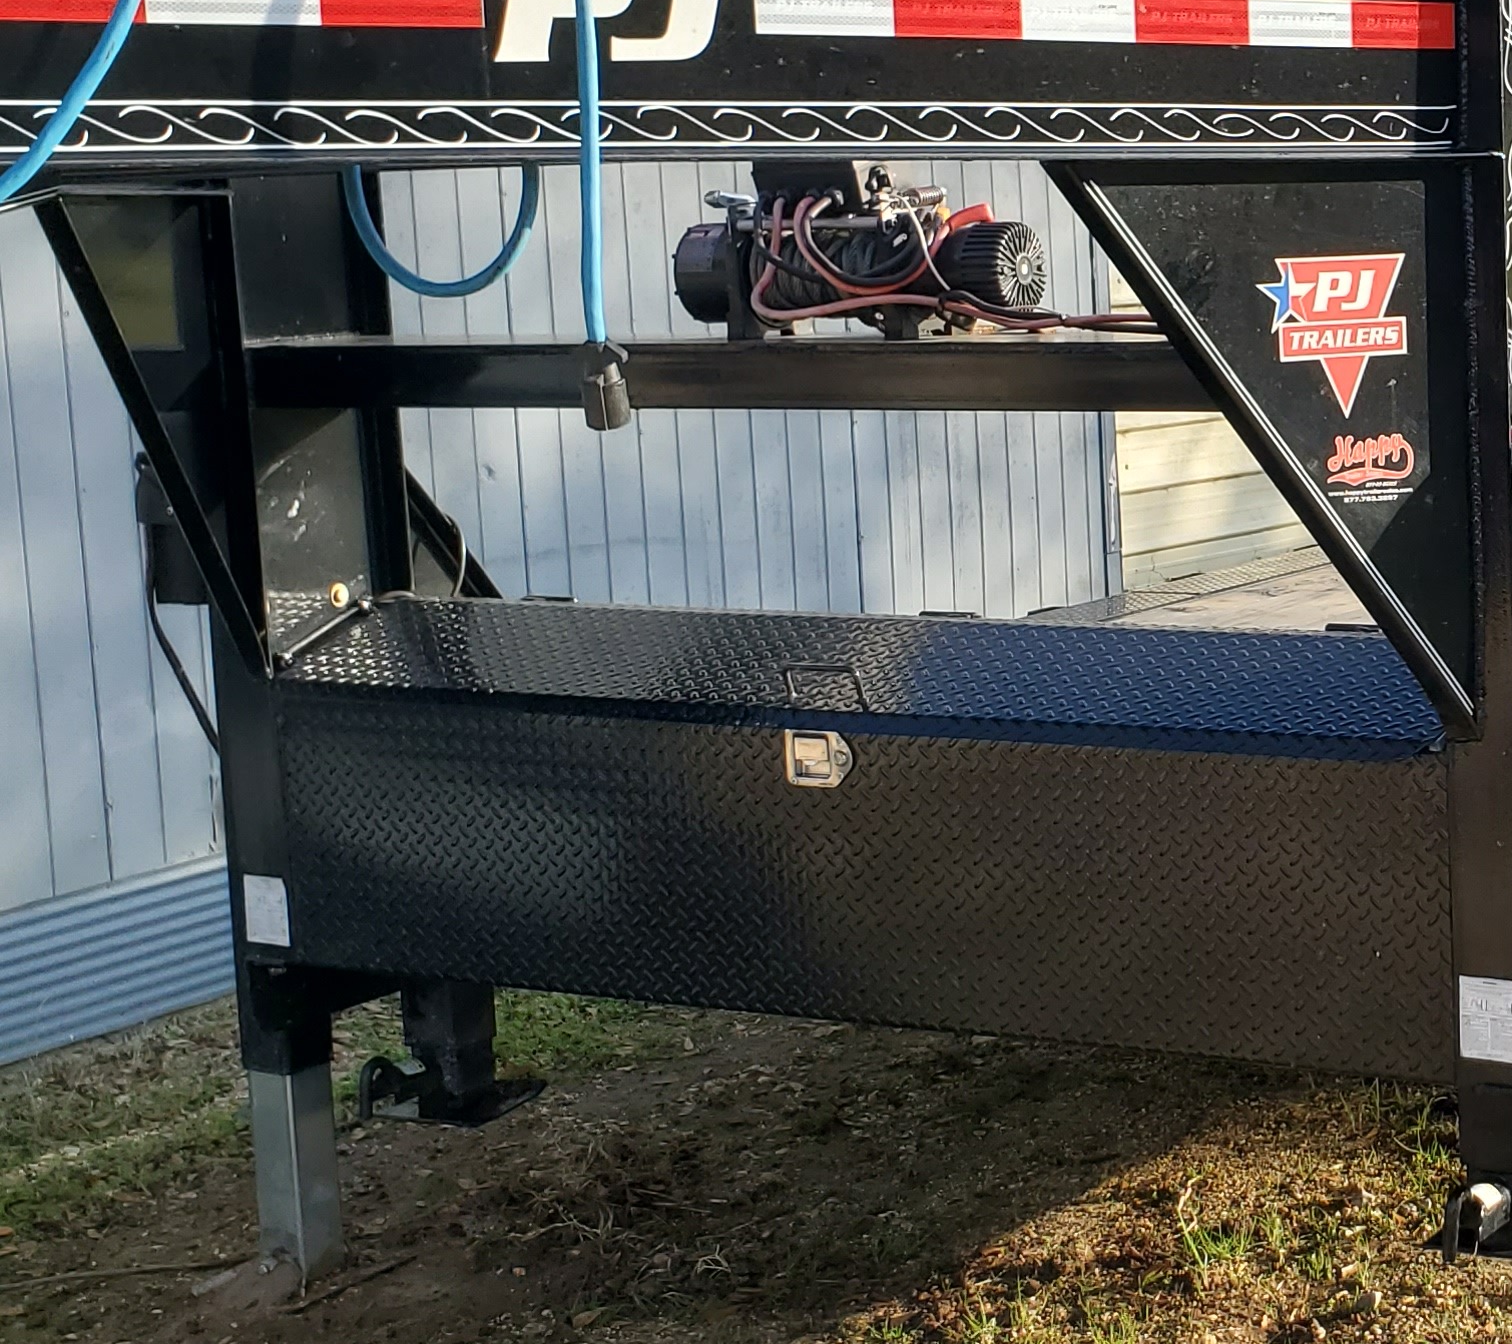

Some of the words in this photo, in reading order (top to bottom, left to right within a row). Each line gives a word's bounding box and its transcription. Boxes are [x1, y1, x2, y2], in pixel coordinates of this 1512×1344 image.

[1312, 269, 1376, 313] PJ
[1290, 326, 1400, 351] TRAILERS
[1327, 433, 1405, 473] Happy
